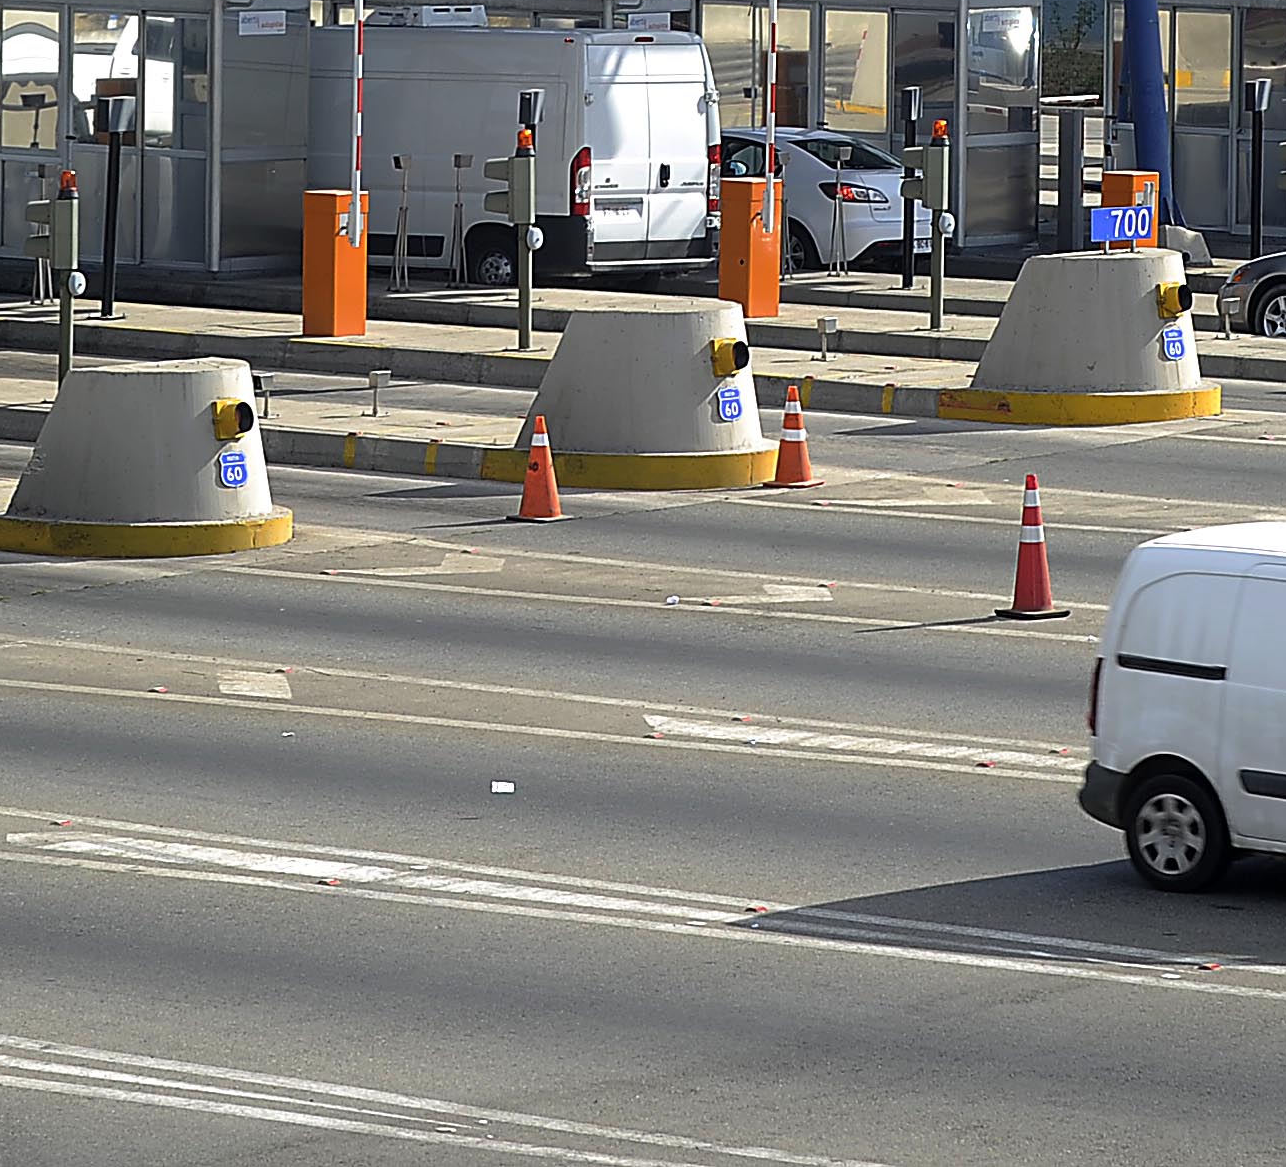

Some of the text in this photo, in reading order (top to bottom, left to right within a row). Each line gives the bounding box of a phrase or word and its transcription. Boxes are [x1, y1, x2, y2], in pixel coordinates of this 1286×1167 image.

[1110, 208, 1150, 238] 700
[1169, 341, 1182, 355] 60
[725, 401, 739, 417] 60
[226, 466, 243, 482] 60
